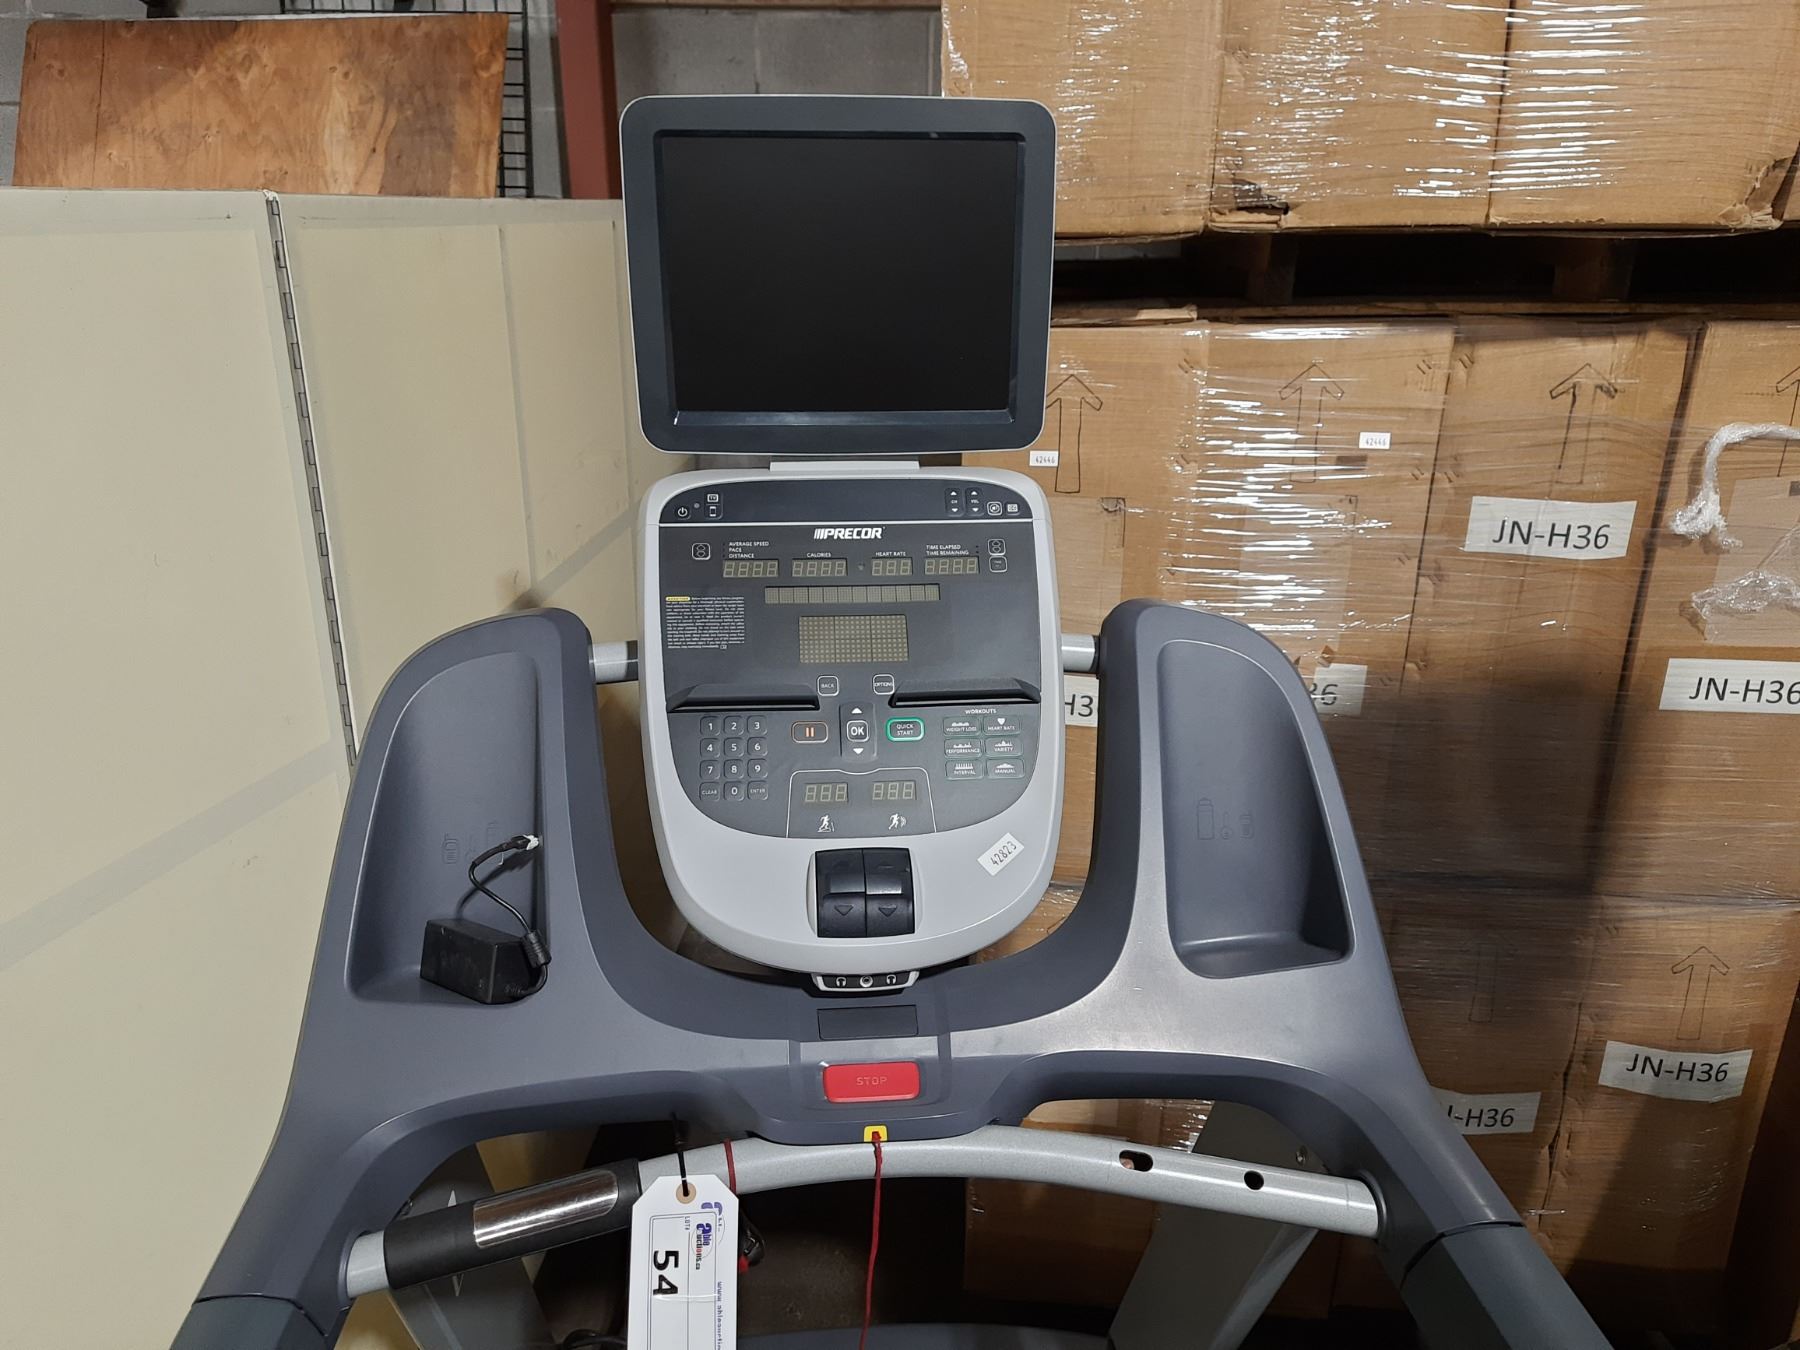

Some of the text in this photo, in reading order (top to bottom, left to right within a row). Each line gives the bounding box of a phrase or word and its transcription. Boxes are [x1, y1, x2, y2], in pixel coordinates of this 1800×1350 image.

[823, 527, 883, 540] PRECOR
[1492, 520, 1611, 549] JN-H36
[1688, 676, 1800, 705] JN-H36
[708, 721, 760, 731] 1 2 3
[850, 726, 865, 736] OK
[706, 743, 761, 752] 4 5 6
[707, 764, 761, 775] 7 8 9
[731, 786, 738, 795] 0
[990, 840, 1017, 866] 42823
[1625, 1053, 1730, 1083] JN-H36
[856, 1077, 888, 1086] STOP
[652, 1249, 680, 1297] 54
